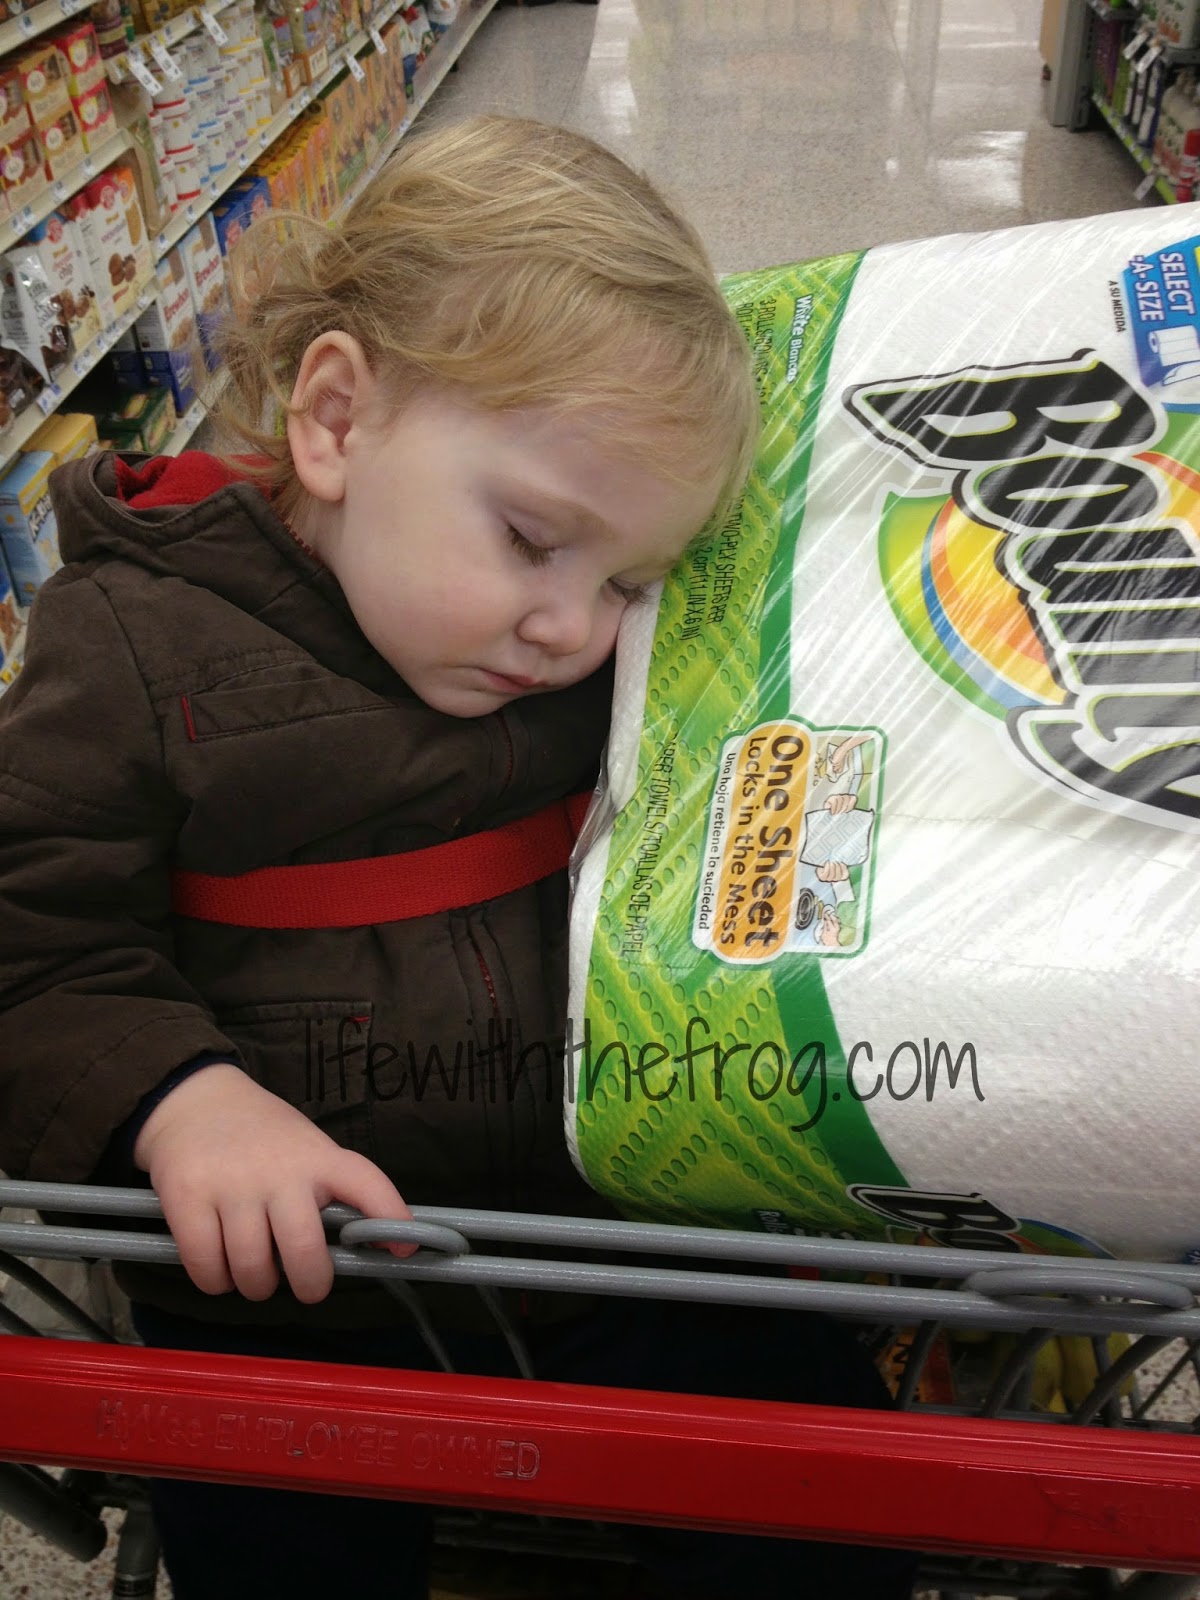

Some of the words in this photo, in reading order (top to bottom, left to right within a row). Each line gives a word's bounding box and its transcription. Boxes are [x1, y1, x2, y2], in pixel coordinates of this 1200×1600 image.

[1110, 287, 1121, 298] SU
[1159, 252, 1196, 316] SELECT
[794, 294, 812, 335] White
[1112, 299, 1126, 332] MEDIDA
[711, 563, 736, 604] SHEETS
[706, 604, 727, 624] PER
[723, 752, 737, 774] Una
[741, 736, 768, 798] Locks
[763, 735, 804, 812] One
[715, 777, 731, 804] hoja
[633, 777, 671, 890] TOWELS/TOALLAS
[709, 807, 726, 853] retiene
[737, 805, 760, 826] in
[708, 856, 720, 868] la
[730, 834, 755, 876] the
[628, 893, 650, 911] DE
[698, 871, 716, 930] suciedad
[744, 825, 793, 948] Sheet
[720, 883, 747, 945] Mess
[620, 915, 648, 957] PAPEL
[213, 1412, 400, 1467] EMPLOYEE
[410, 1429, 541, 1480] OWNED
